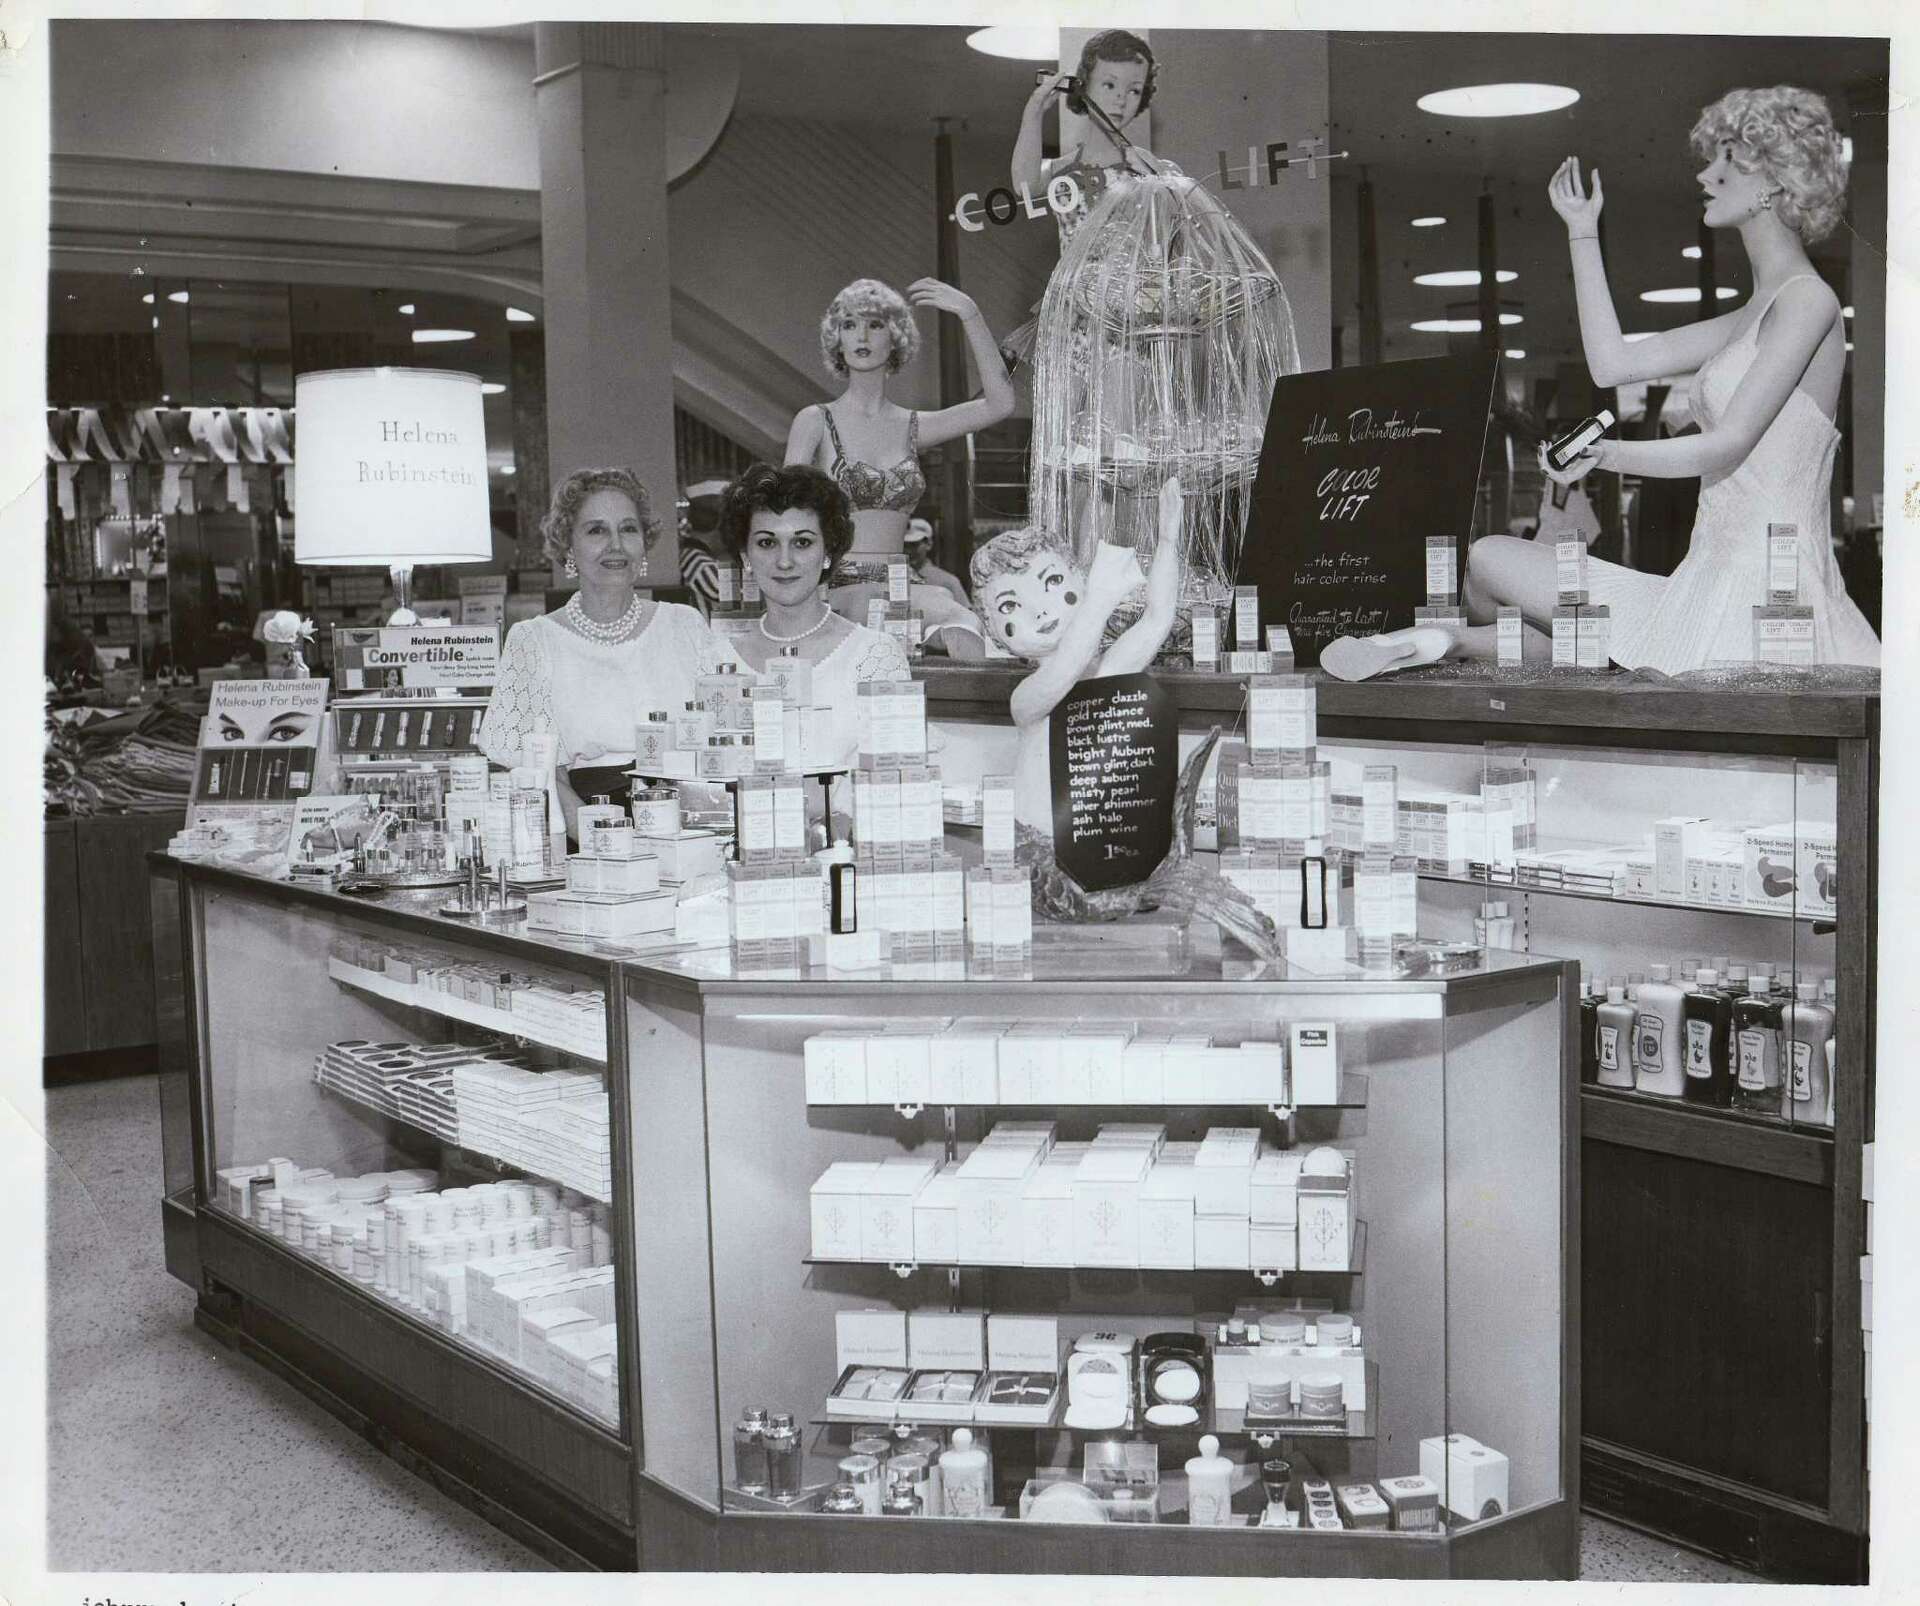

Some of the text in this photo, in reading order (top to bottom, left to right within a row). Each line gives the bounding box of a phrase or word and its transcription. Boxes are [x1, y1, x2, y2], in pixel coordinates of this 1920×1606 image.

[1215, 136, 1325, 191] LIFT
[378, 420, 458, 445] Helena
[1302, 412, 1339, 454] Helena
[354, 459, 478, 487] Rubinstein
[1316, 465, 1381, 498] COLOR
[1319, 494, 1370, 521] LIFT
[1338, 551, 1371, 566] first
[1293, 570, 1389, 585] hair color rinse
[411, 635, 493, 646] Helena Rubinstein
[368, 647, 464, 664] Convertible
[217, 680, 321, 693] Helena Rubinstein
[215, 695, 320, 708] Make-up For Eyes
[1067, 690, 1148, 711] copper dazzle
[1067, 706, 1144, 726] gold radiance
[1067, 724, 1095, 734] brown
[1127, 717, 1154, 728] med.
[1067, 733, 1131, 747] black lustre
[1068, 745, 1155, 762] bright Auburn
[1069, 762, 1101, 773] brown
[1130, 757, 1154, 768] dark
[1070, 772, 1139, 788] deep auburn
[1070, 783, 1140, 800] misty pearl
[1072, 797, 1157, 812] silver shimmer
[1073, 811, 1123, 826] ash halo
[1073, 824, 1139, 843] plum wine
